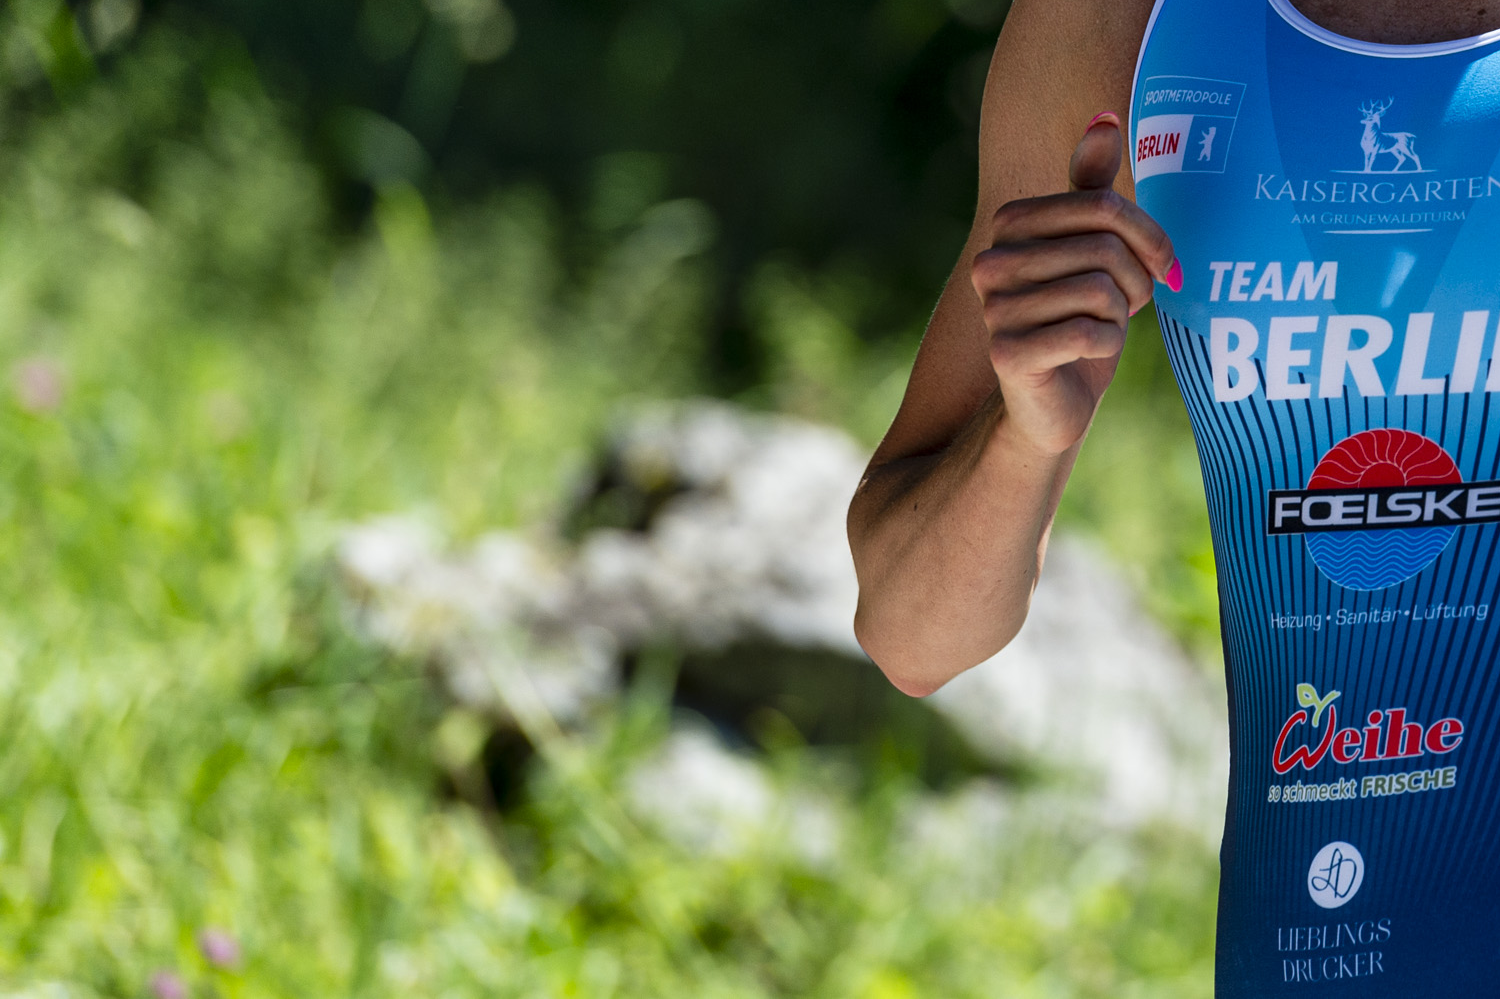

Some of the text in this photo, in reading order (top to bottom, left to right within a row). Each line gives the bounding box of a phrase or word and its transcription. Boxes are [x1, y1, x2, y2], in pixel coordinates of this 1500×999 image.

[1144, 89, 1232, 106] SPORTMETROPOLE
[1137, 132, 1181, 162] BERLIN
[1291, 210, 1466, 225] AM GRUNEWALDTURM
[1209, 261, 1338, 302] TEAM
[1271, 603, 1489, 631] Heizung Sanitär Lüftung
[1282, 777, 1357, 803] schmeckt
[1360, 766, 1457, 798] FRISCHE
[1278, 918, 1391, 951] LIEBLINGS
[1283, 951, 1384, 982] DRUCKER
